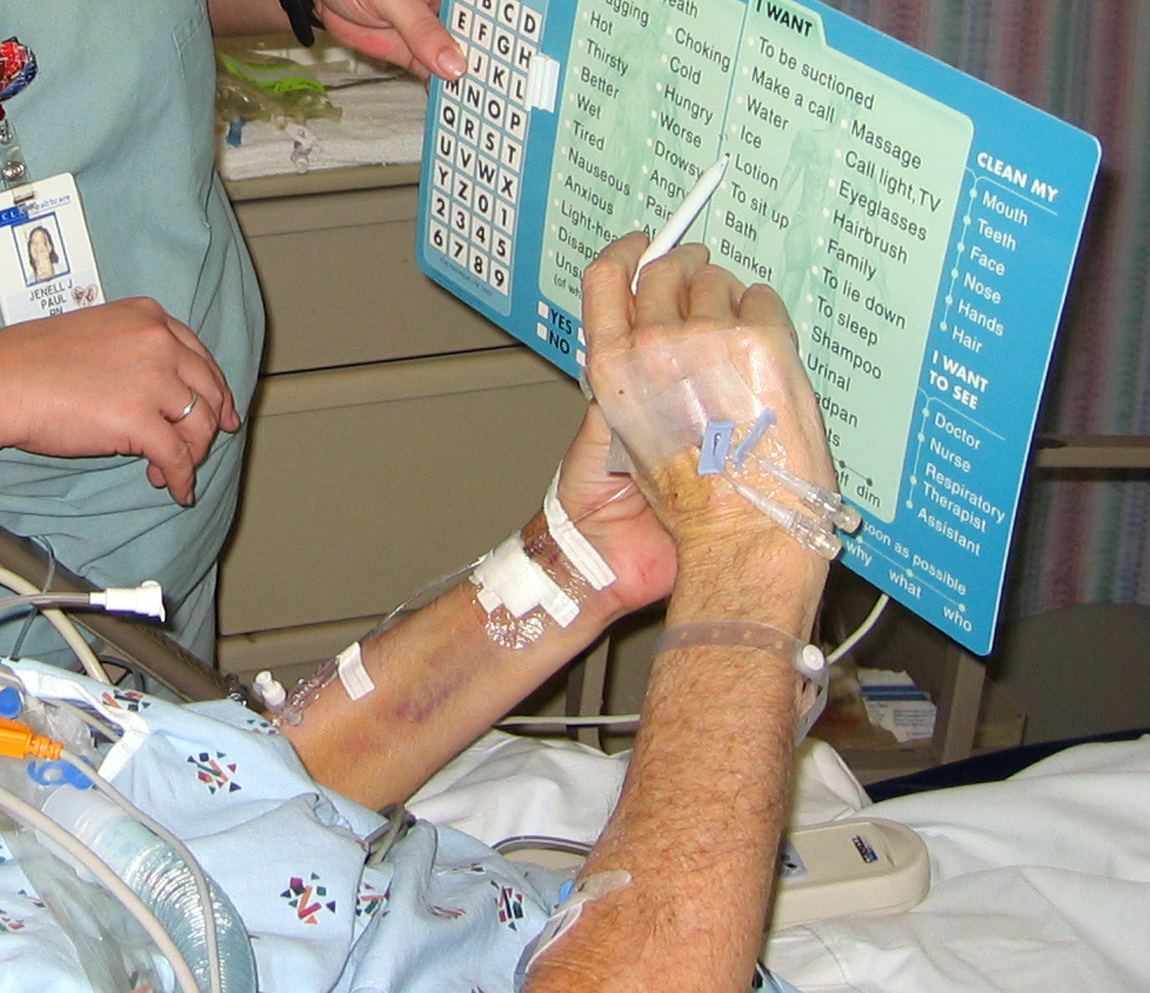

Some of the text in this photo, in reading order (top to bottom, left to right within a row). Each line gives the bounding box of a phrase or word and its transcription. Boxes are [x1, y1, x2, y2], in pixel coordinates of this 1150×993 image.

[503, 3, 514, 23] C
[524, 13, 536, 34] D
[590, 10, 613, 36] Hot
[767, 2, 813, 37] WANT
[458, 11, 532, 69] E F G H
[586, 38, 629, 77] Thirsty
[674, 27, 731, 73] Choking
[473, 56, 524, 100] J K L
[581, 66, 619, 99] Better
[669, 56, 702, 85] Cold
[759, 36, 875, 111] To be suctioned
[445, 80, 521, 130] M N O P
[576, 92, 602, 119] Wet
[664, 84, 714, 126] Hungry
[746, 94, 789, 131] Water
[751, 66, 836, 124] Make a call
[442, 105, 517, 164] Q R S T
[573, 120, 604, 151] Tired
[660, 112, 702, 148] Worse
[740, 125, 762, 149] Ice
[850, 119, 922, 170] Massage
[441, 136, 513, 199] U V W X
[568, 147, 631, 197] Nauseous
[654, 140, 705, 182] Drowsy
[735, 153, 779, 191] Lotion
[845, 150, 876, 179] Call
[977, 152, 1059, 203] CLEAN MY
[438, 166, 449, 186] Y
[458, 180, 469, 201] Z
[500, 208, 508, 227] 1
[564, 175, 614, 215] Anxious
[731, 181, 791, 231] To sit up
[838, 179, 927, 242] Eyeglasses
[982, 191, 1029, 227] Mouth
[436, 197, 506, 257] 2 3 4 5
[560, 199, 619, 243] Light-hea
[725, 210, 758, 242] Bath
[832, 208, 908, 265] Hairbrush
[977, 218, 1018, 253] Teeth
[433, 229, 443, 248] 6
[453, 242, 464, 259] 7
[474, 255, 483, 275] 8
[494, 268, 505, 287] 9
[558, 226, 600, 261] Disapp
[720, 239, 773, 283] Blanket
[827, 238, 877, 282] Family
[969, 245, 1006, 277] Face
[28, 281, 66, 302] JENELL
[40, 293, 68, 311] PAUL
[822, 266, 907, 330] To lie down
[963, 272, 1002, 305] Nose
[550, 309, 573, 336] YES
[816, 294, 879, 347] To sleep
[958, 299, 1005, 337] Hands
[550, 329, 571, 355] NO
[810, 325, 883, 381] Shampoo
[952, 325, 984, 354] Hair
[806, 353, 852, 393] Urinal
[929, 369, 980, 411] TO SEE
[932, 349, 990, 394] I WANT
[934, 411, 982, 451] Doctor
[929, 437, 972, 474] Nurse
[856, 483, 882, 509] dim
[923, 481, 988, 534] Therapist
[925, 462, 1006, 524] Respiratory
[917, 507, 982, 557] Assistant
[845, 541, 974, 633] why what who
[894, 541, 911, 559] as
[912, 553, 968, 597] possible
